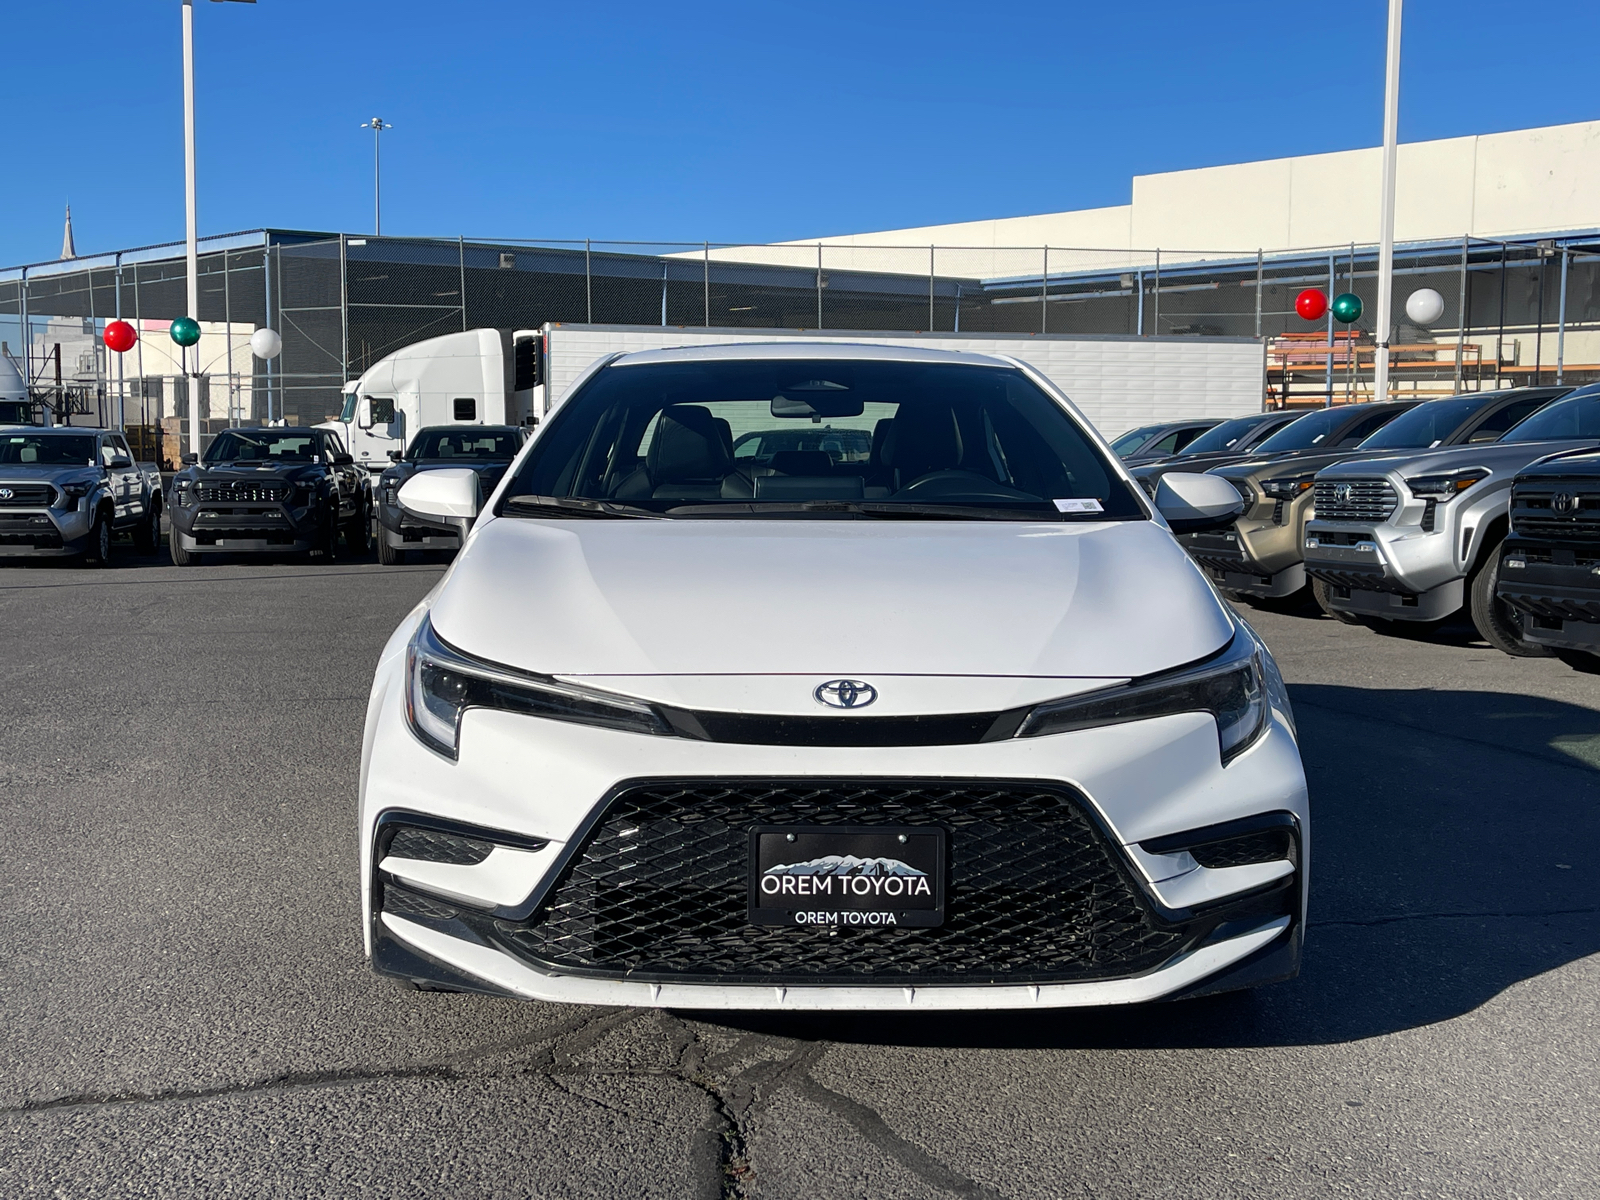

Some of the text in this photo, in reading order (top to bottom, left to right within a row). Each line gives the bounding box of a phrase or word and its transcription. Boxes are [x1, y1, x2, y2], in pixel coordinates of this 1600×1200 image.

[761, 875, 931, 896] OREM TOYOTA
[795, 911, 897, 925] OREM TOYOTA
